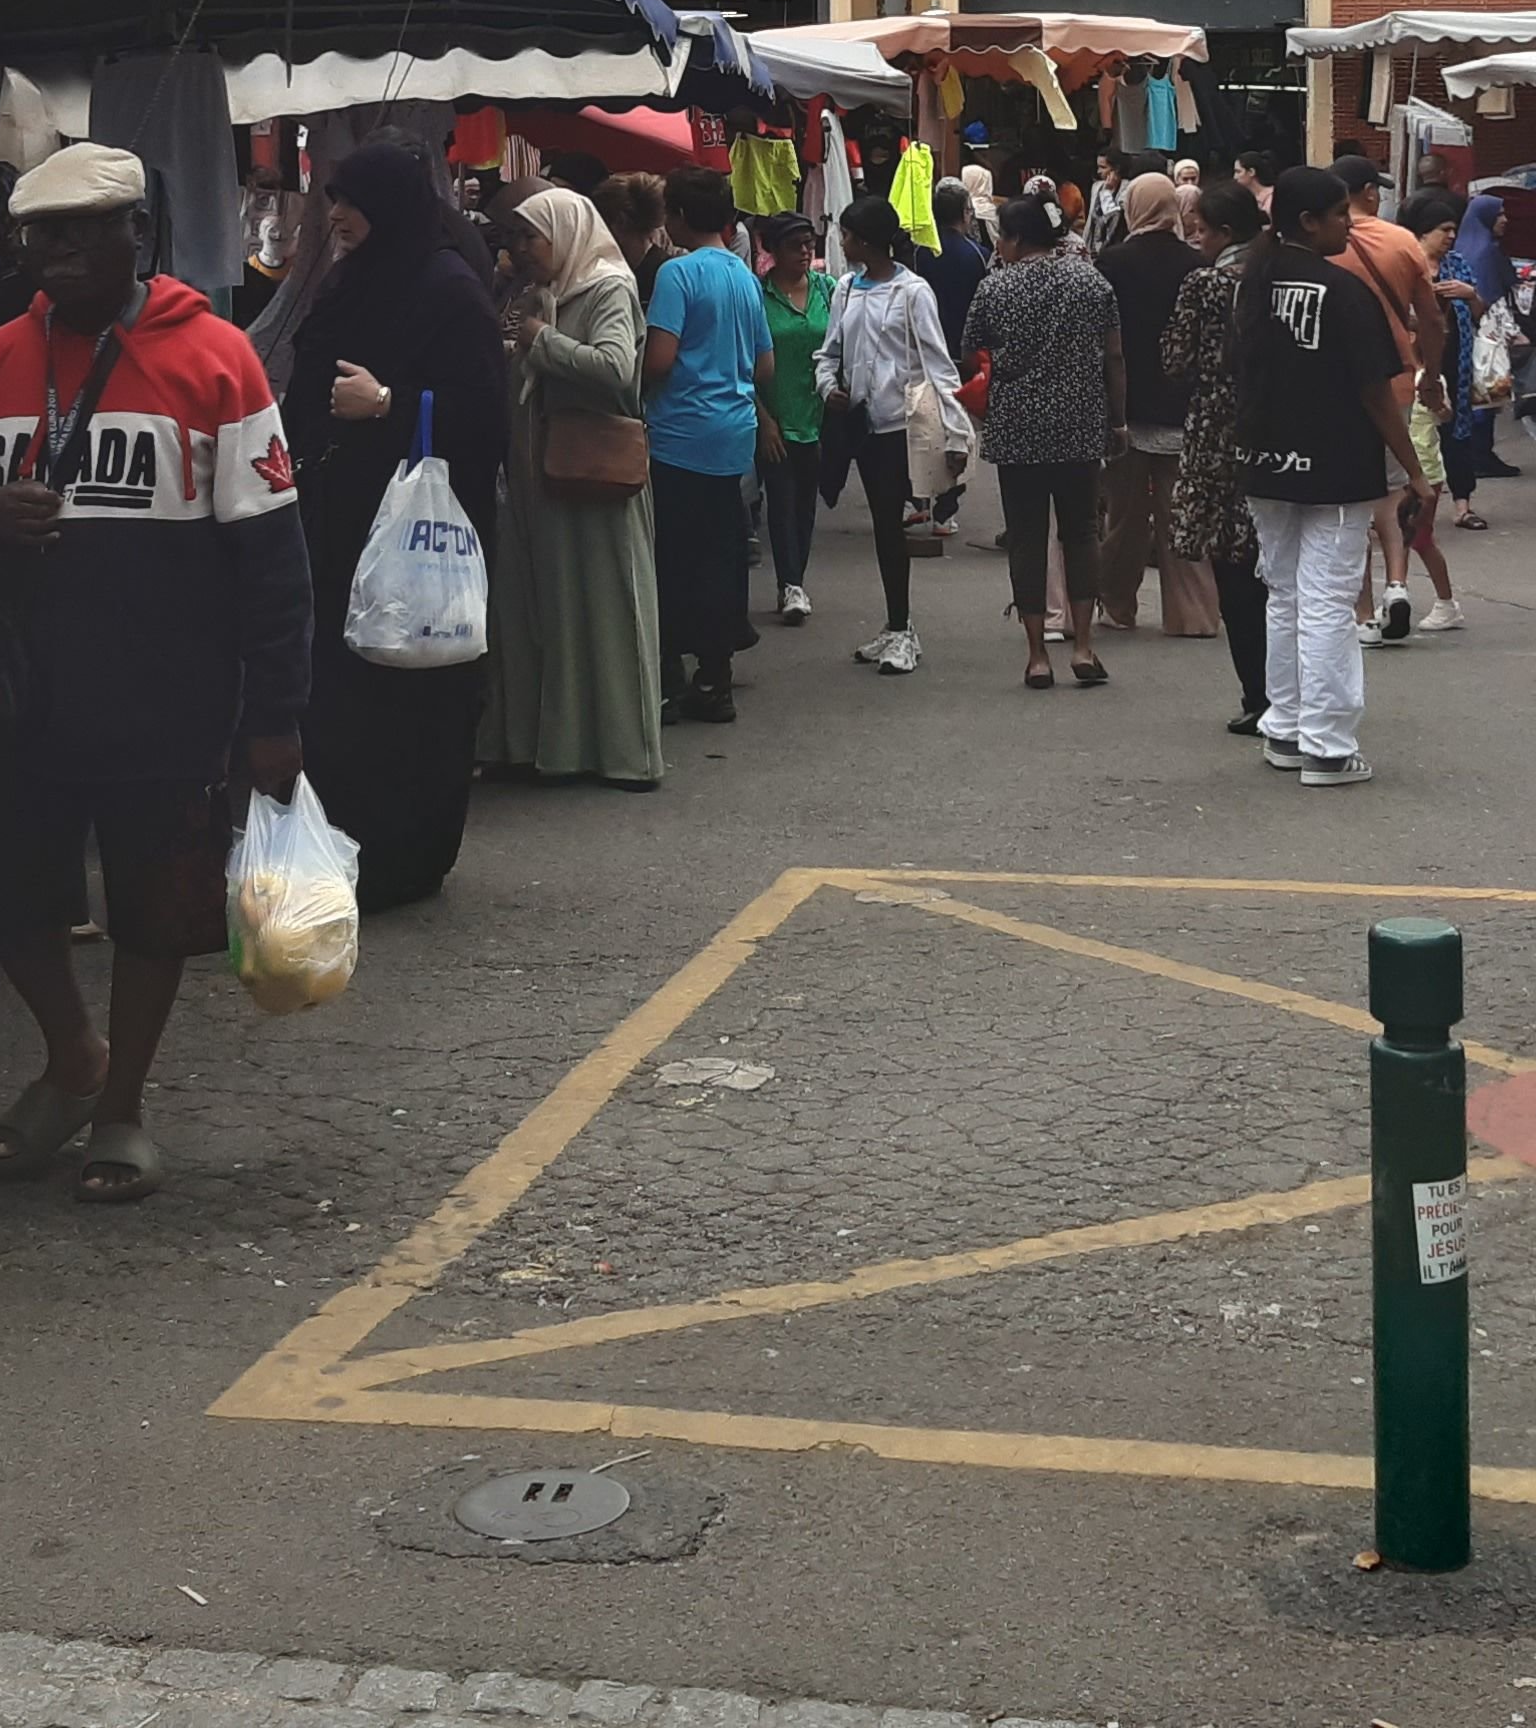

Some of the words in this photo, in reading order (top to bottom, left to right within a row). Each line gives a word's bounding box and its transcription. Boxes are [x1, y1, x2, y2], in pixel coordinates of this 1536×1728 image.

[1428, 1184, 1445, 1198] TU
[1447, 1180, 1462, 1195] ES
[1431, 1217, 1463, 1237] POUR
[1423, 1264, 1438, 1280] IL
